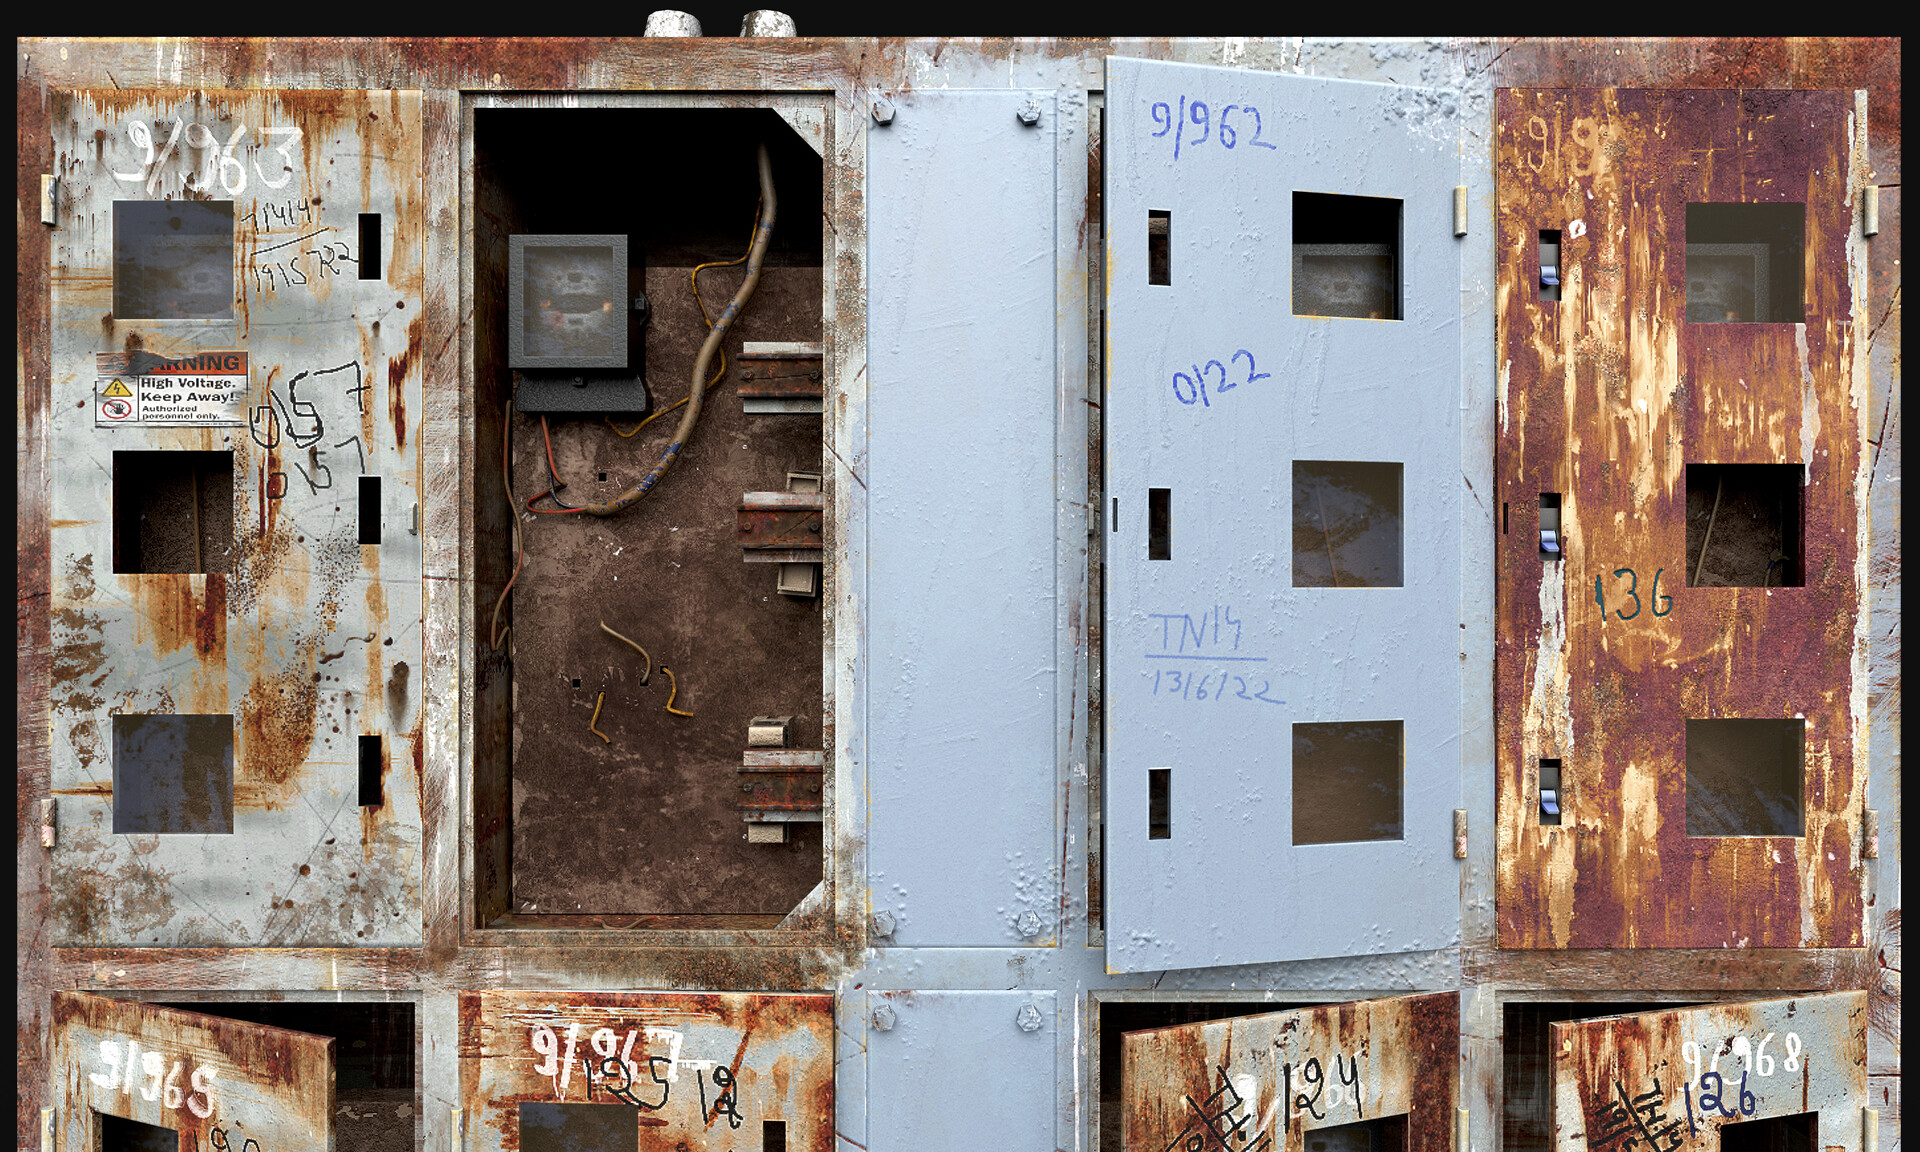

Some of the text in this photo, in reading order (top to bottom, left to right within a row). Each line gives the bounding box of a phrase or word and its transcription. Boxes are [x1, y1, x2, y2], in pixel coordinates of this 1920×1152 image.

[112, 115, 303, 196] 9/963
[1151, 95, 1277, 162] 9/962
[141, 377, 236, 390] High Voltage.
[141, 392, 235, 404] Keep Away!
[142, 405, 198, 413] Authorized
[142, 412, 220, 421] personnel only.
[1595, 568, 1673, 622] 136
[1676, 1031, 1802, 1093] 9/968
[1284, 1053, 1363, 1136] 124
[1684, 1070, 1757, 1139] 126
